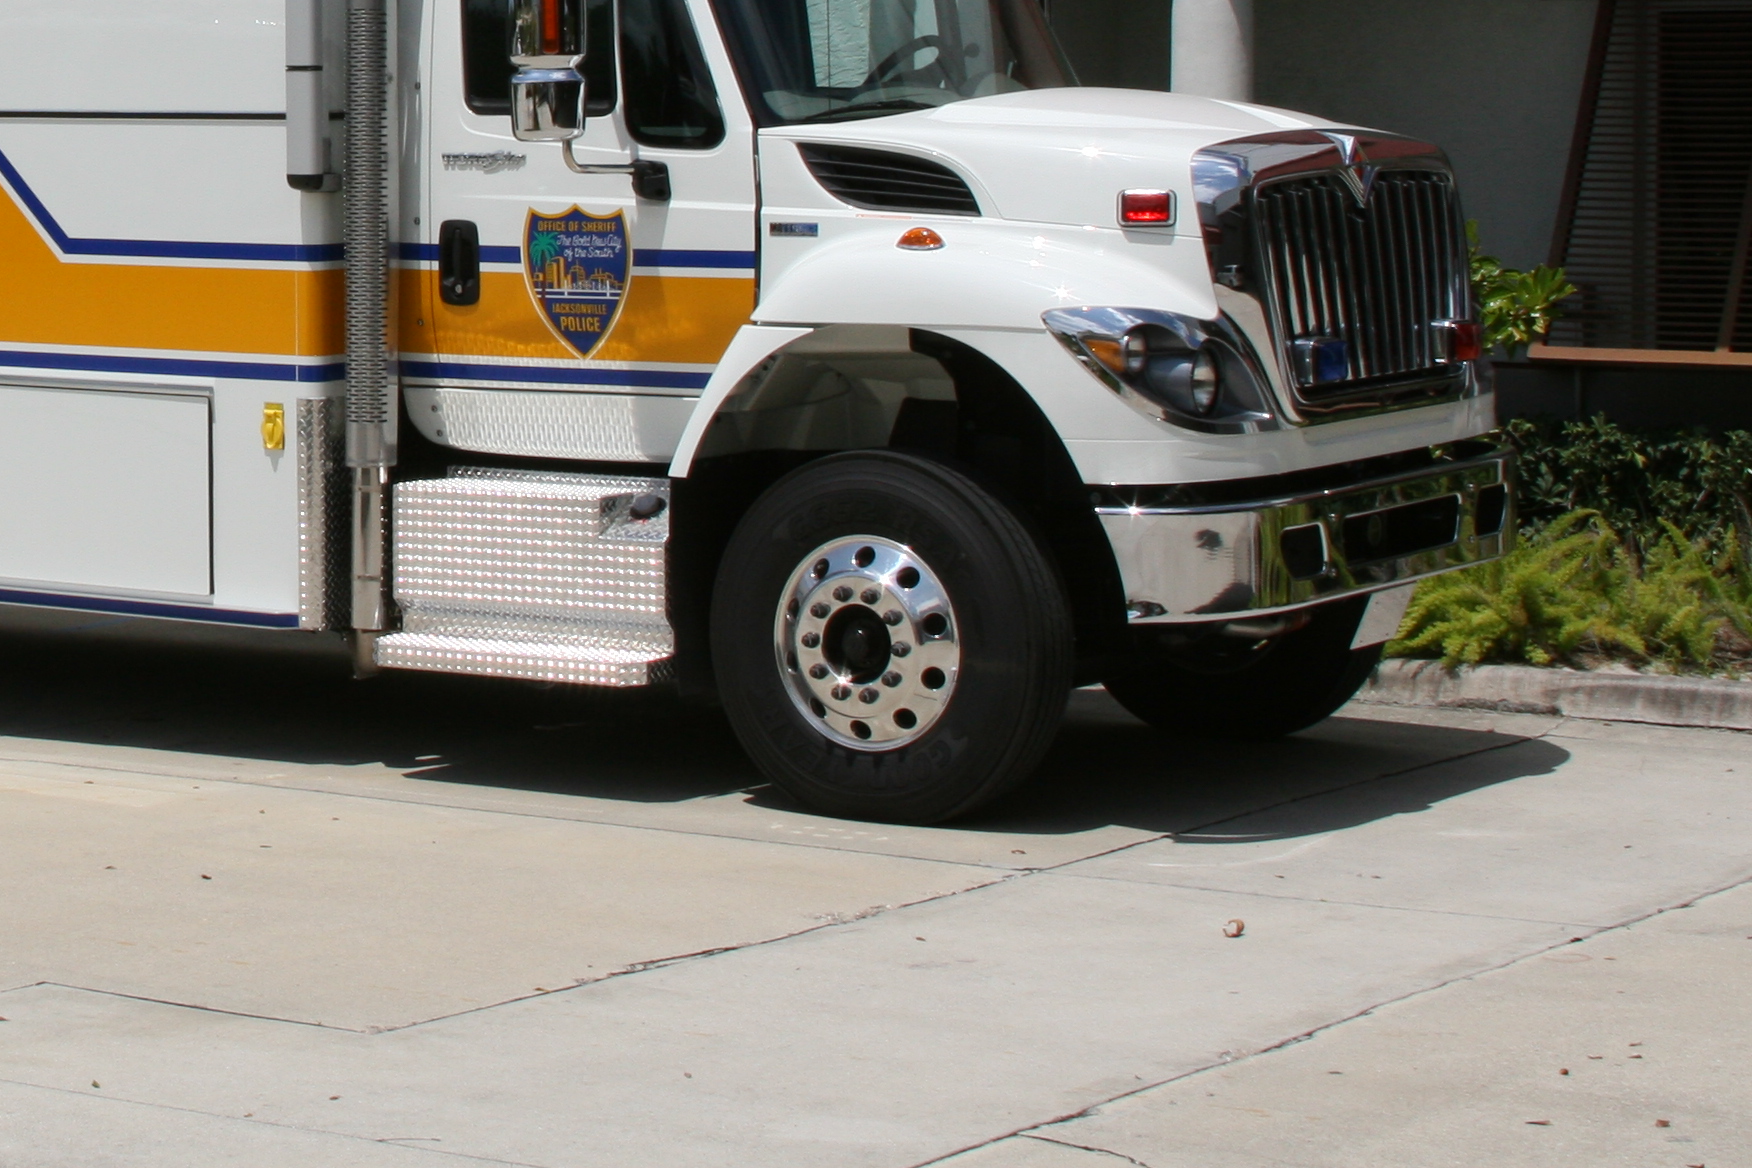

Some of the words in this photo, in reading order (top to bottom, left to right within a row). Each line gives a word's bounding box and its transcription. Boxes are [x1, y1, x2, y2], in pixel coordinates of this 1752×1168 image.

[538, 220, 565, 232] OFFICE
[568, 221, 579, 232] OF
[581, 221, 617, 232] SHERIFF
[563, 248, 574, 262] of
[574, 247, 587, 258] the
[587, 247, 614, 258] South
[552, 303, 608, 316] JACKSONVILLE
[560, 316, 600, 332] POLICE
